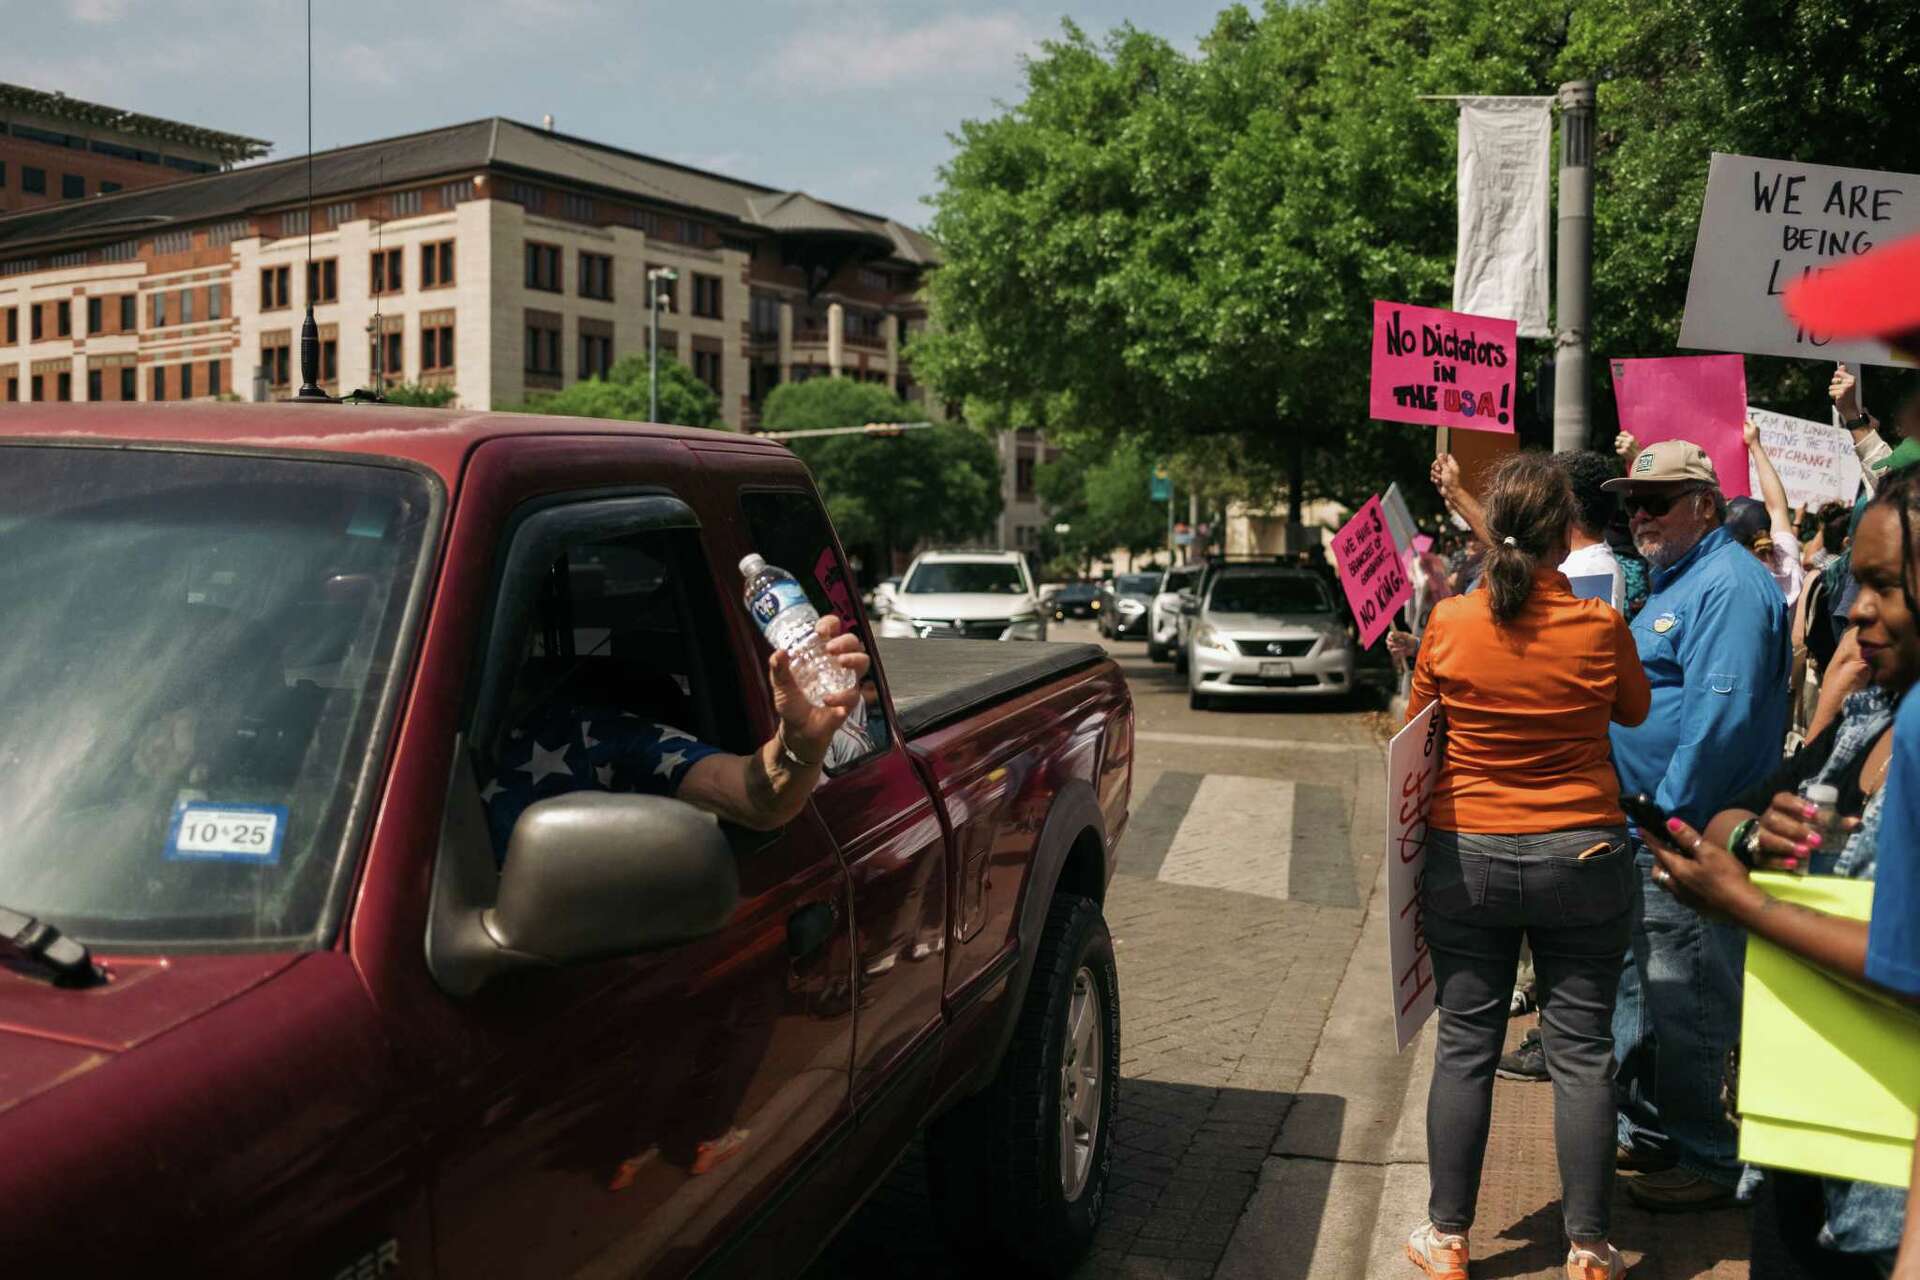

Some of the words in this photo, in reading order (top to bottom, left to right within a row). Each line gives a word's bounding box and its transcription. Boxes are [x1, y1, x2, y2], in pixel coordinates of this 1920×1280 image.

[1754, 171, 1806, 214] WE
[1823, 180, 1904, 222] ARE
[1783, 225, 1873, 256] BEING
[1386, 310, 1416, 357] No
[1422, 323, 1508, 368] Dictators
[1392, 384, 1438, 411] THE
[1369, 507, 1383, 533] 3
[1359, 598, 1377, 630] NO
[185, 822, 218, 843] 10
[231, 824, 267, 846] 25
